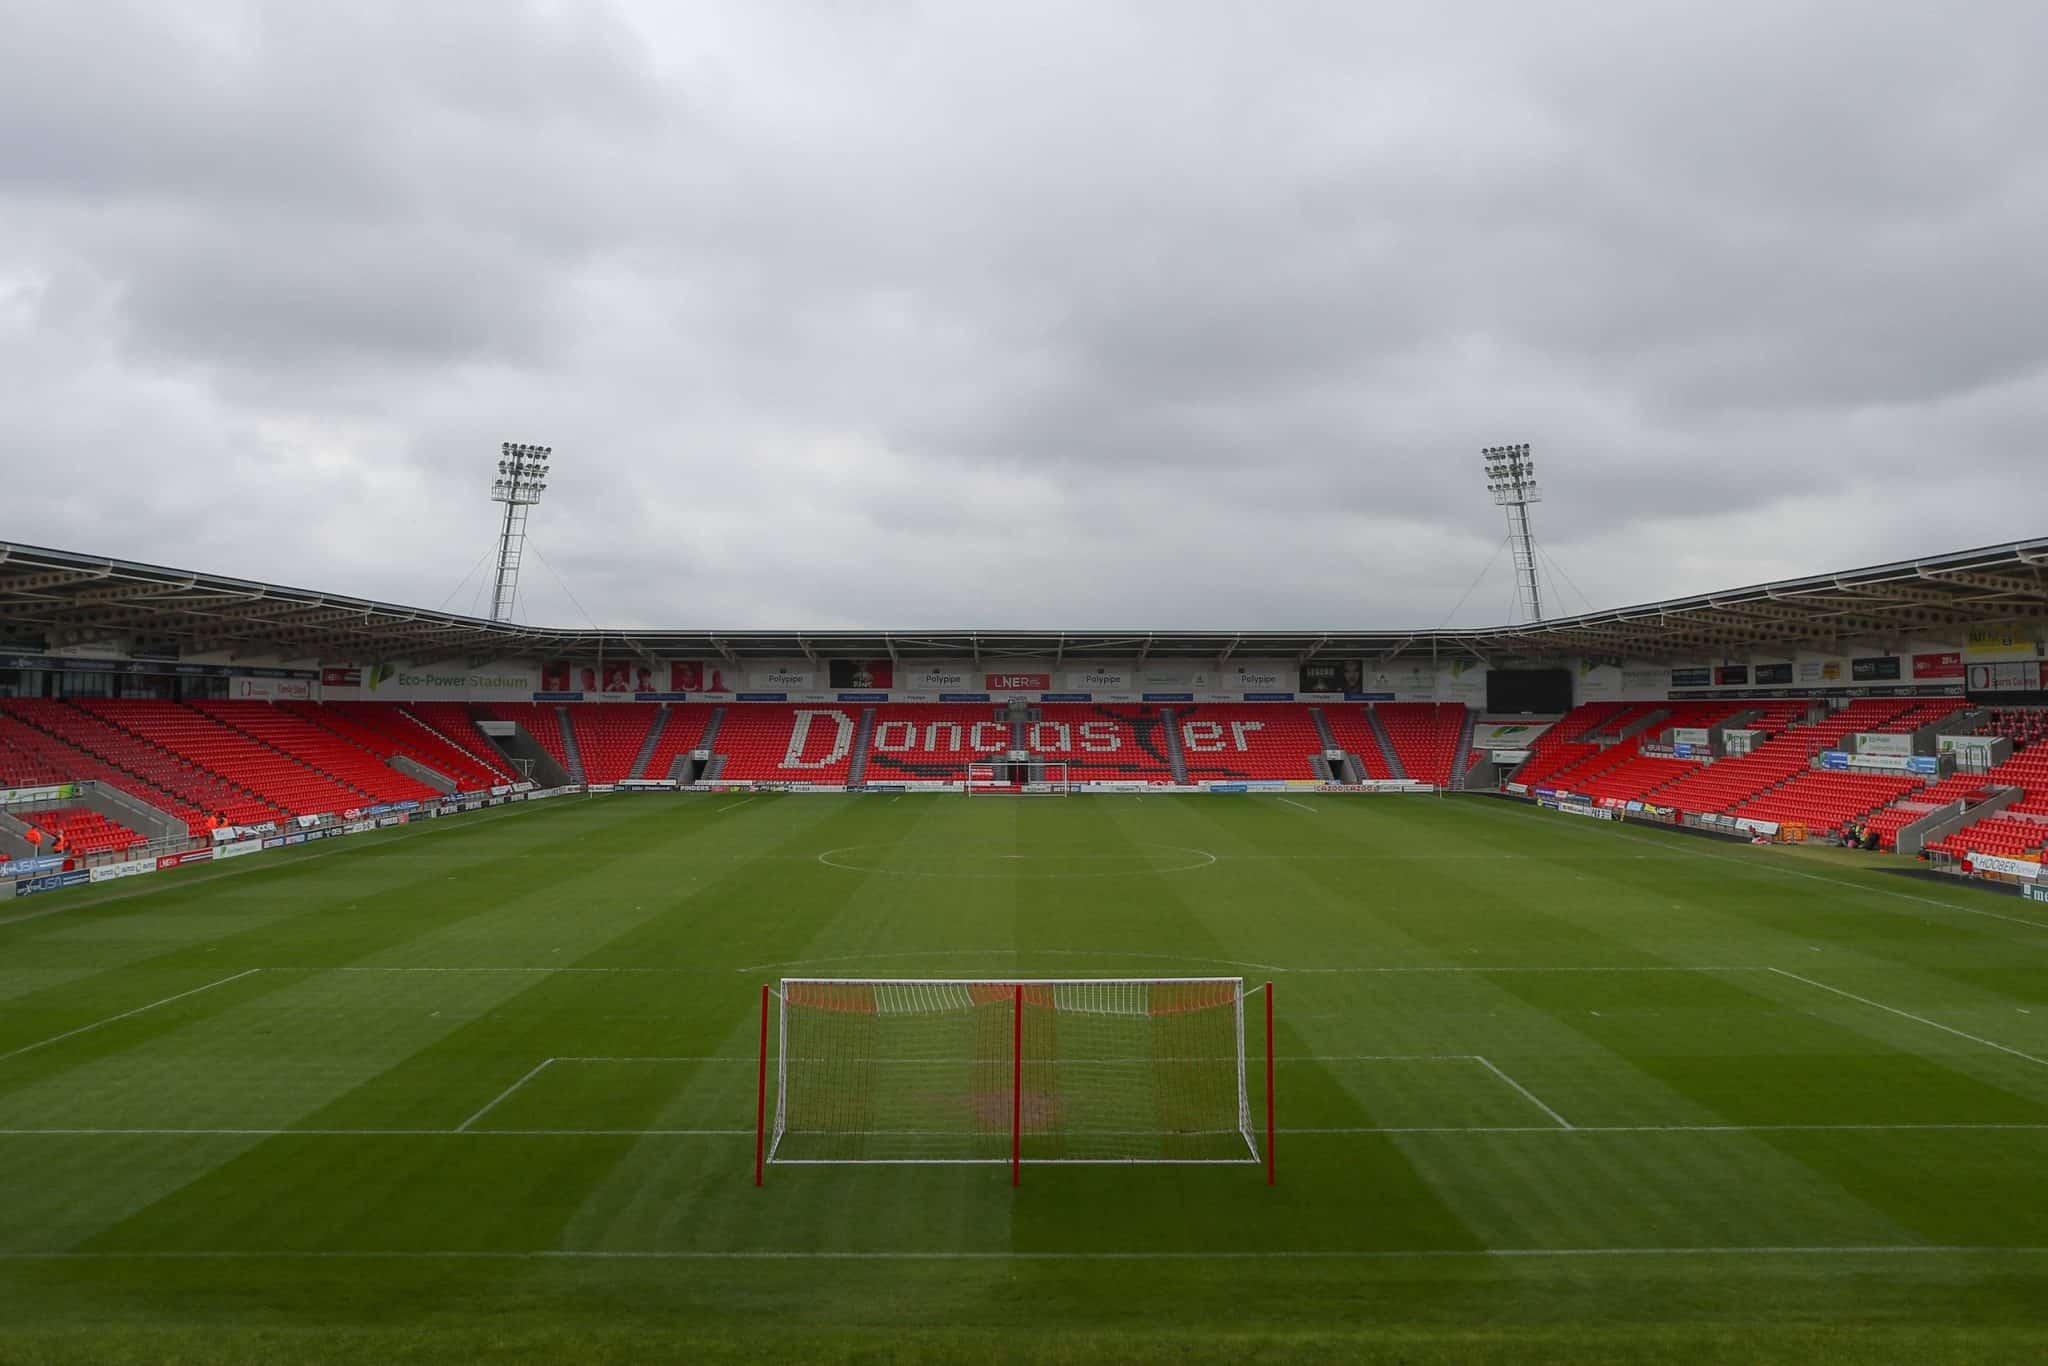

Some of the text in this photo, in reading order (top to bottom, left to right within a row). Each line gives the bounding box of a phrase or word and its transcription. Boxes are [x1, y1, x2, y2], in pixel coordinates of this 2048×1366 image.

[398, 673, 528, 688] Eco-Power Stadium
[994, 676, 1030, 688] LNER
